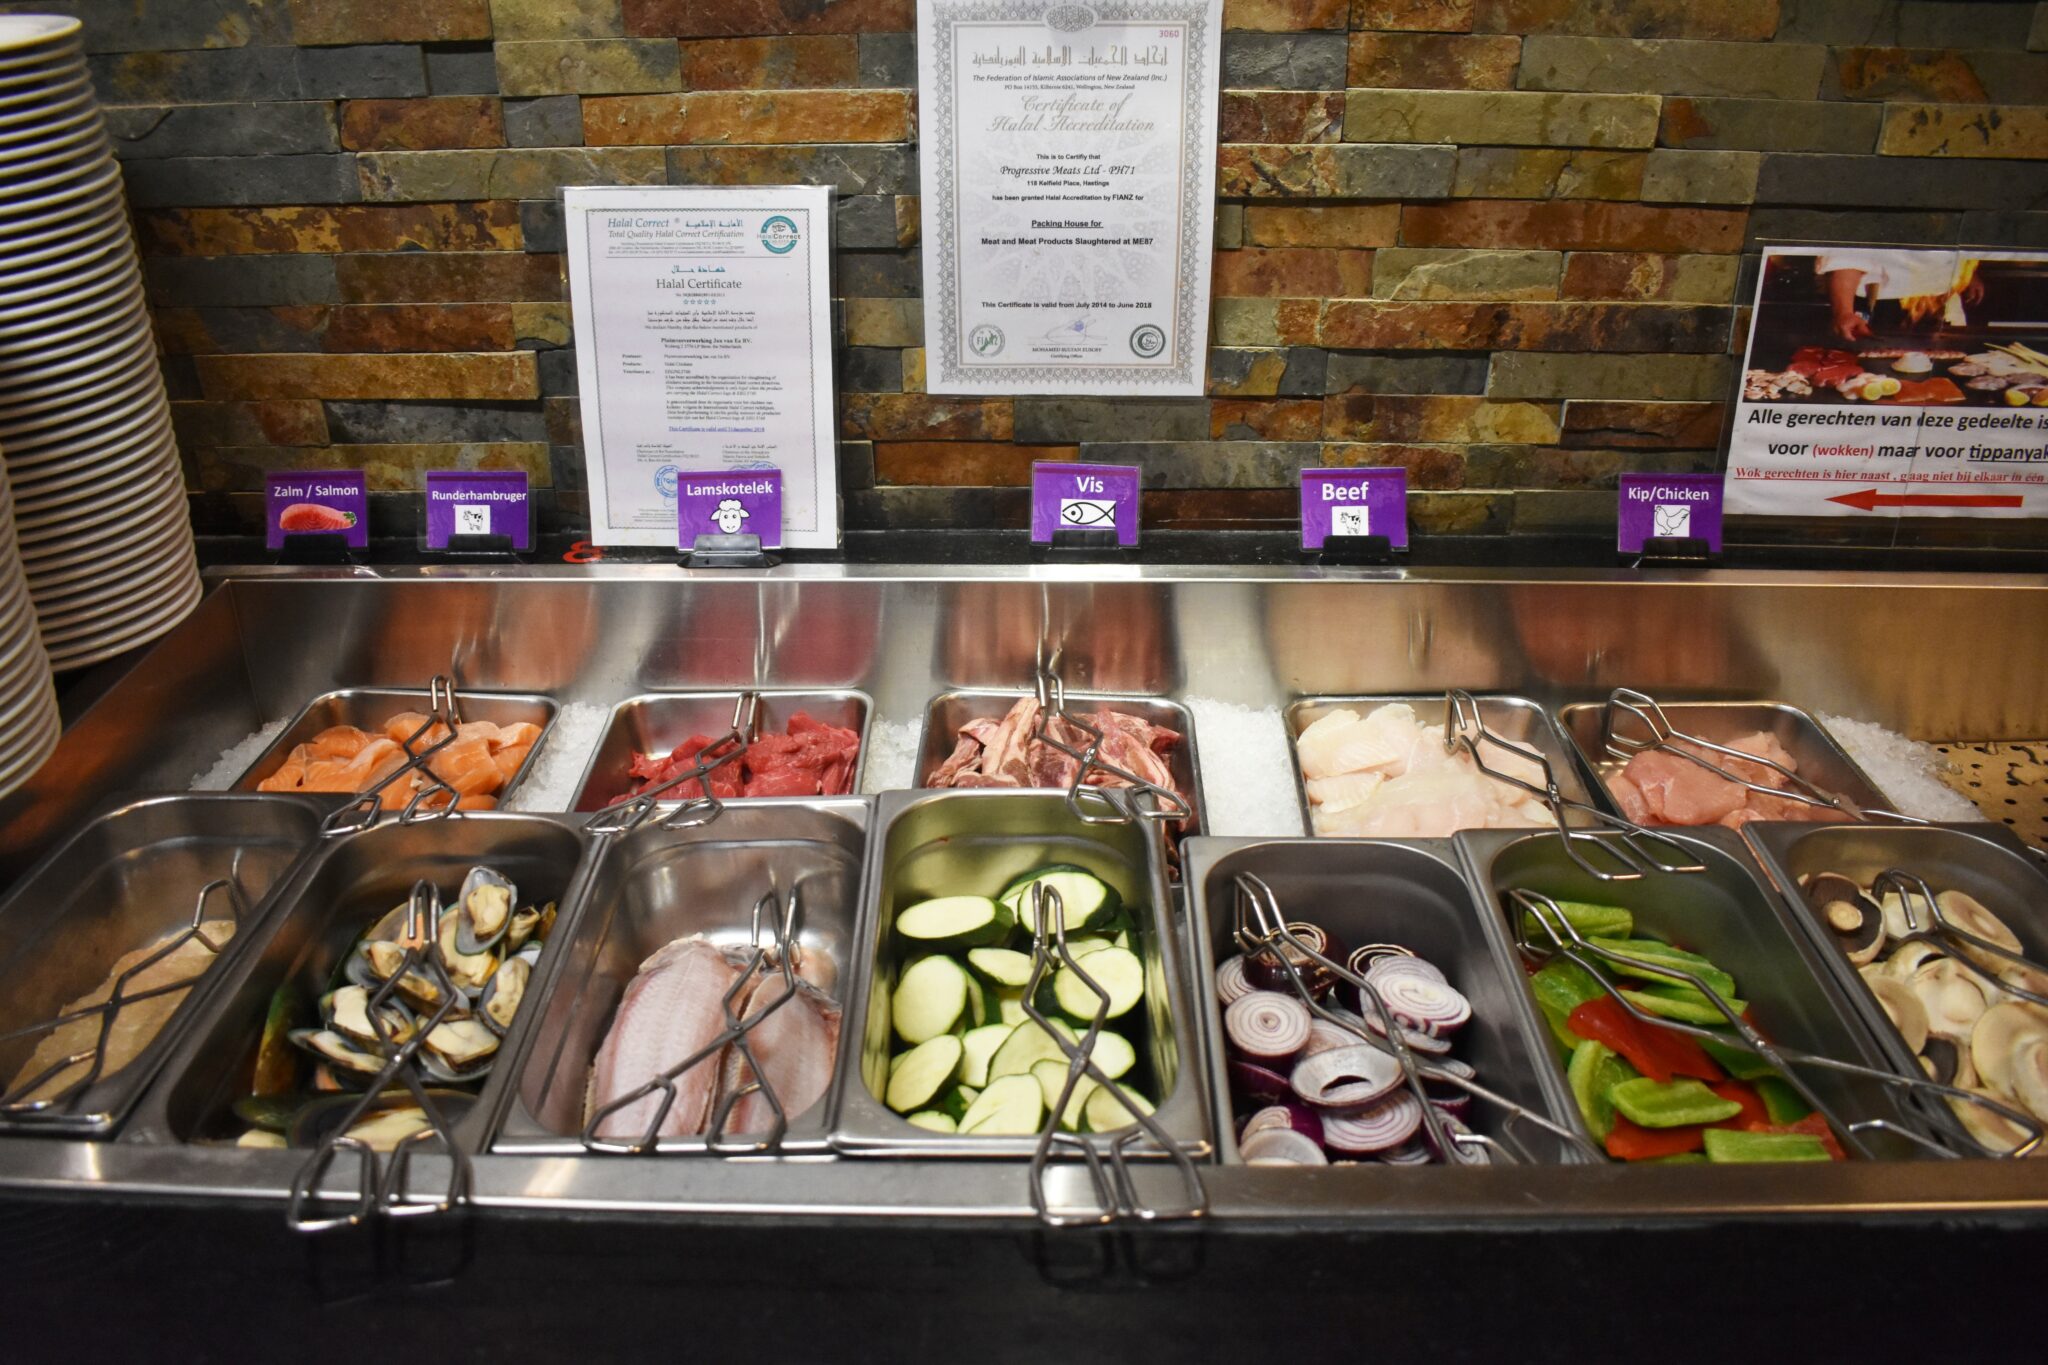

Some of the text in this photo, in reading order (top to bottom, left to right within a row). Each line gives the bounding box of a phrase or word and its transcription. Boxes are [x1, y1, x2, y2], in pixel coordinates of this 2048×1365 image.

[1159, 30, 1179, 38] 3060
[1023, 74, 1032, 82] of
[1122, 74, 1149, 82] Zealand
[1150, 74, 1167, 82] (Inc.)
[1021, 92, 1133, 118] Certificate of
[986, 113, 1155, 131] Halal Accreditation
[1000, 165, 1050, 178] Progressive
[1052, 165, 1081, 175] Meats
[1083, 164, 1102, 175] Ltd
[1108, 165, 1136, 176] PH71
[607, 218, 633, 228] Halal
[635, 218, 669, 228] Correct
[1031, 220, 1102, 228] Packing House for
[608, 229, 745, 240] Total Quality Halal Correct Certification
[1075, 238, 1121, 246] Slaughtered
[656, 278, 742, 289] Halal Certificate
[1076, 301, 1090, 309] July
[1748, 409, 1782, 424] Alle
[1786, 410, 1876, 428] gerechten
[1881, 415, 1912, 427] van
[1957, 413, 2034, 432] gedeelte
[1768, 443, 1808, 456] voor
[1812, 444, 1875, 459] (wokken)
[1877, 445, 1921, 458] maar
[1925, 446, 1964, 458] voor
[1736, 467, 1761, 478] Wok
[1764, 468, 1819, 480] gerechten
[1822, 469, 1831, 479] is
[1835, 469, 1858, 480] hier
[1860, 471, 1890, 481] naast
[1900, 473, 1930, 483] gaag
[1932, 471, 1953, 481] niet
[1956, 471, 1972, 483] bij
[1974, 472, 2009, 482] elkaar
[2011, 472, 2022, 482] in
[686, 480, 773, 496] Lamskotelek
[1075, 476, 1104, 493] Vis
[274, 485, 359, 498] Zalm / Salmon
[432, 490, 527, 502] Runderhambruger
[1321, 482, 1369, 501] Beef
[1628, 486, 1710, 502] Kip/Chicken
